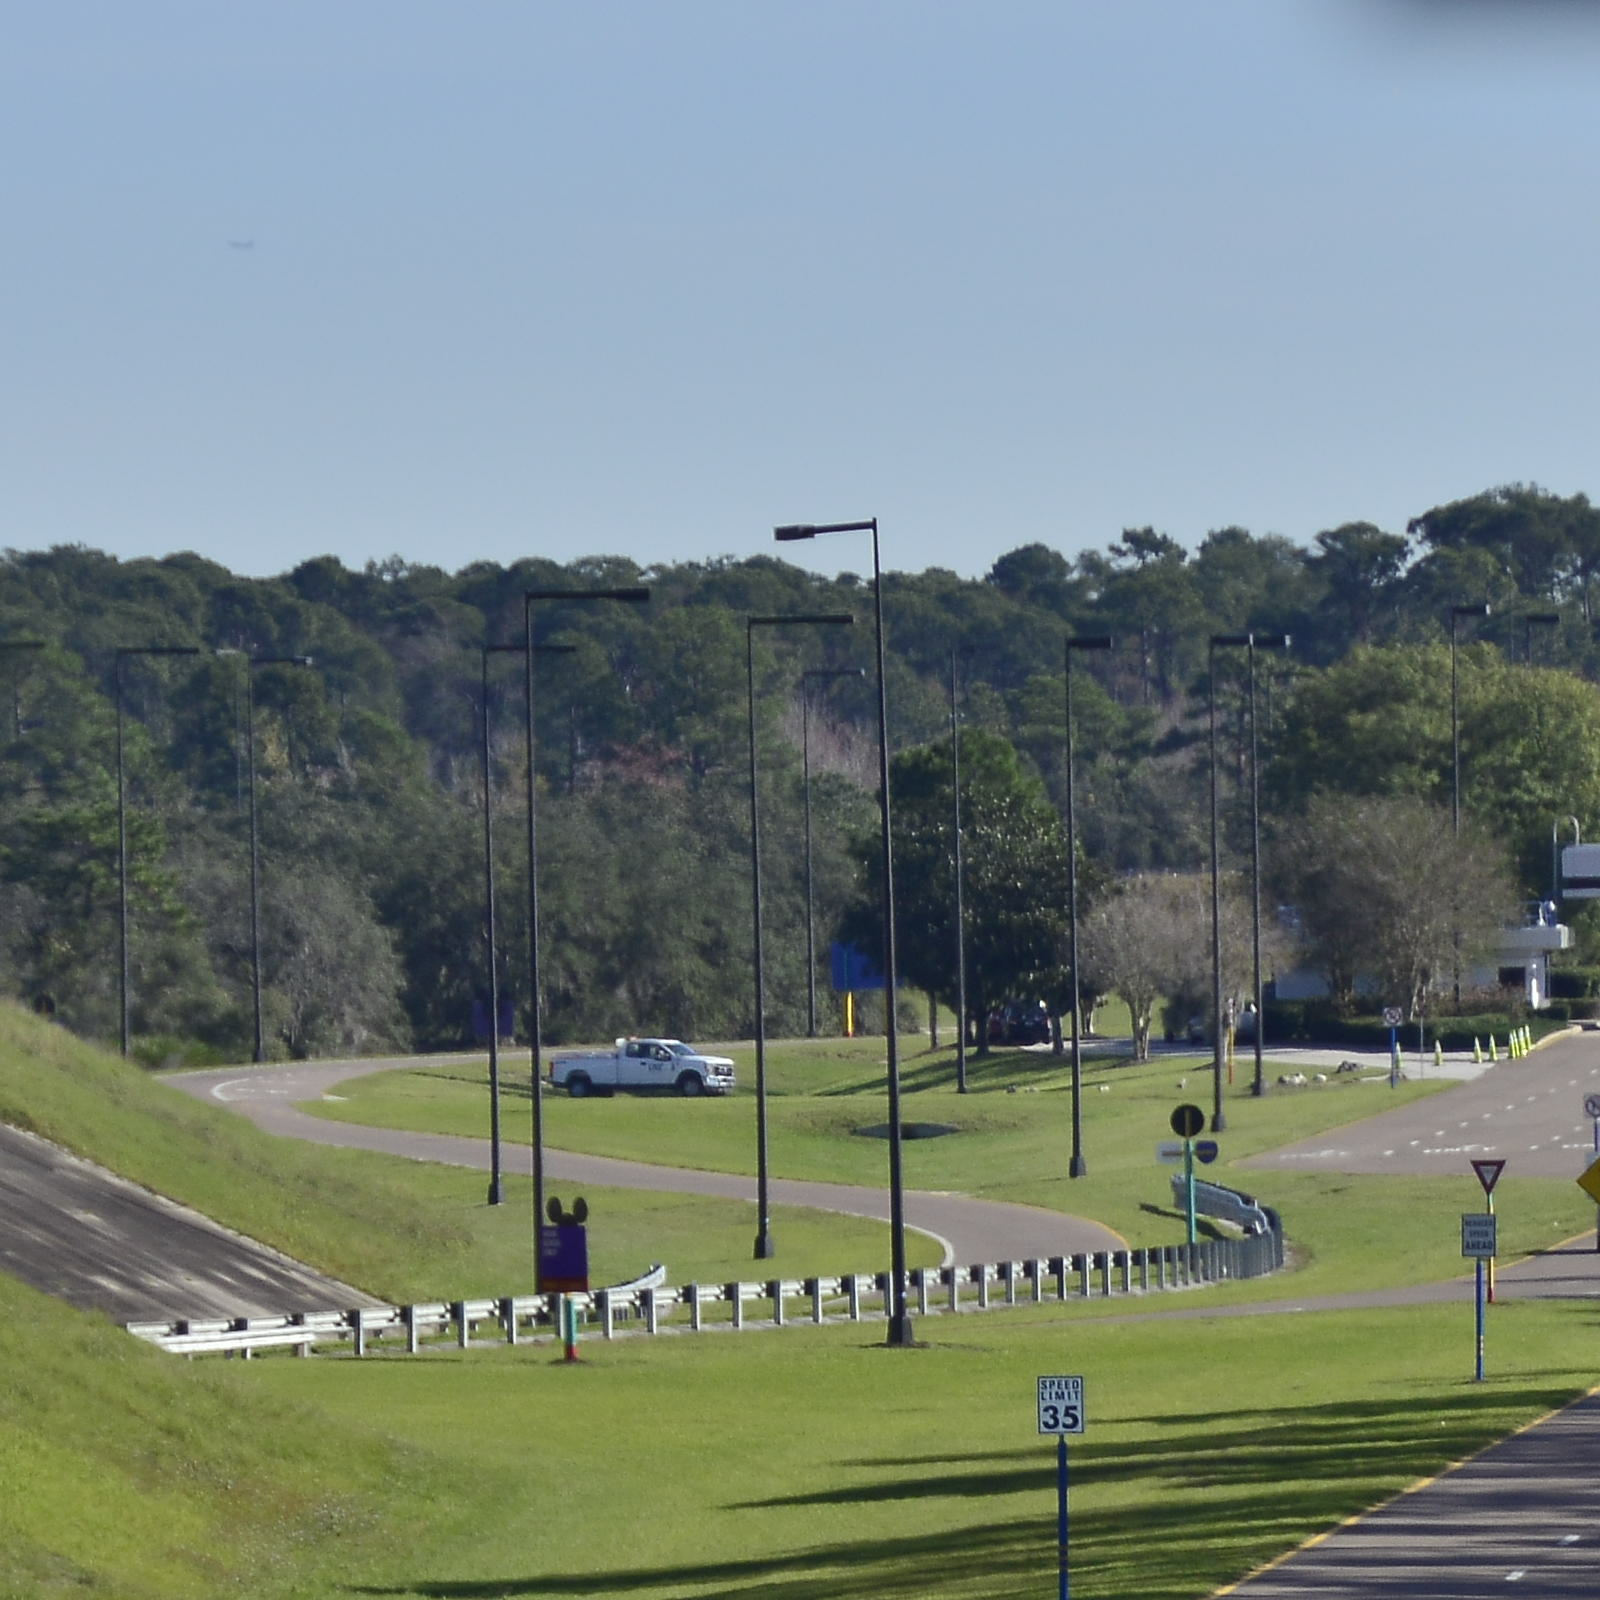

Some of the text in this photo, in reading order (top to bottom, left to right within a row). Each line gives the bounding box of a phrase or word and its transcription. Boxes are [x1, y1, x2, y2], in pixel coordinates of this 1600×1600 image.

[1041, 1380, 1079, 1390] SPEED
[1041, 1391, 1079, 1400] LIMIT
[1042, 1405, 1080, 1429] 35
